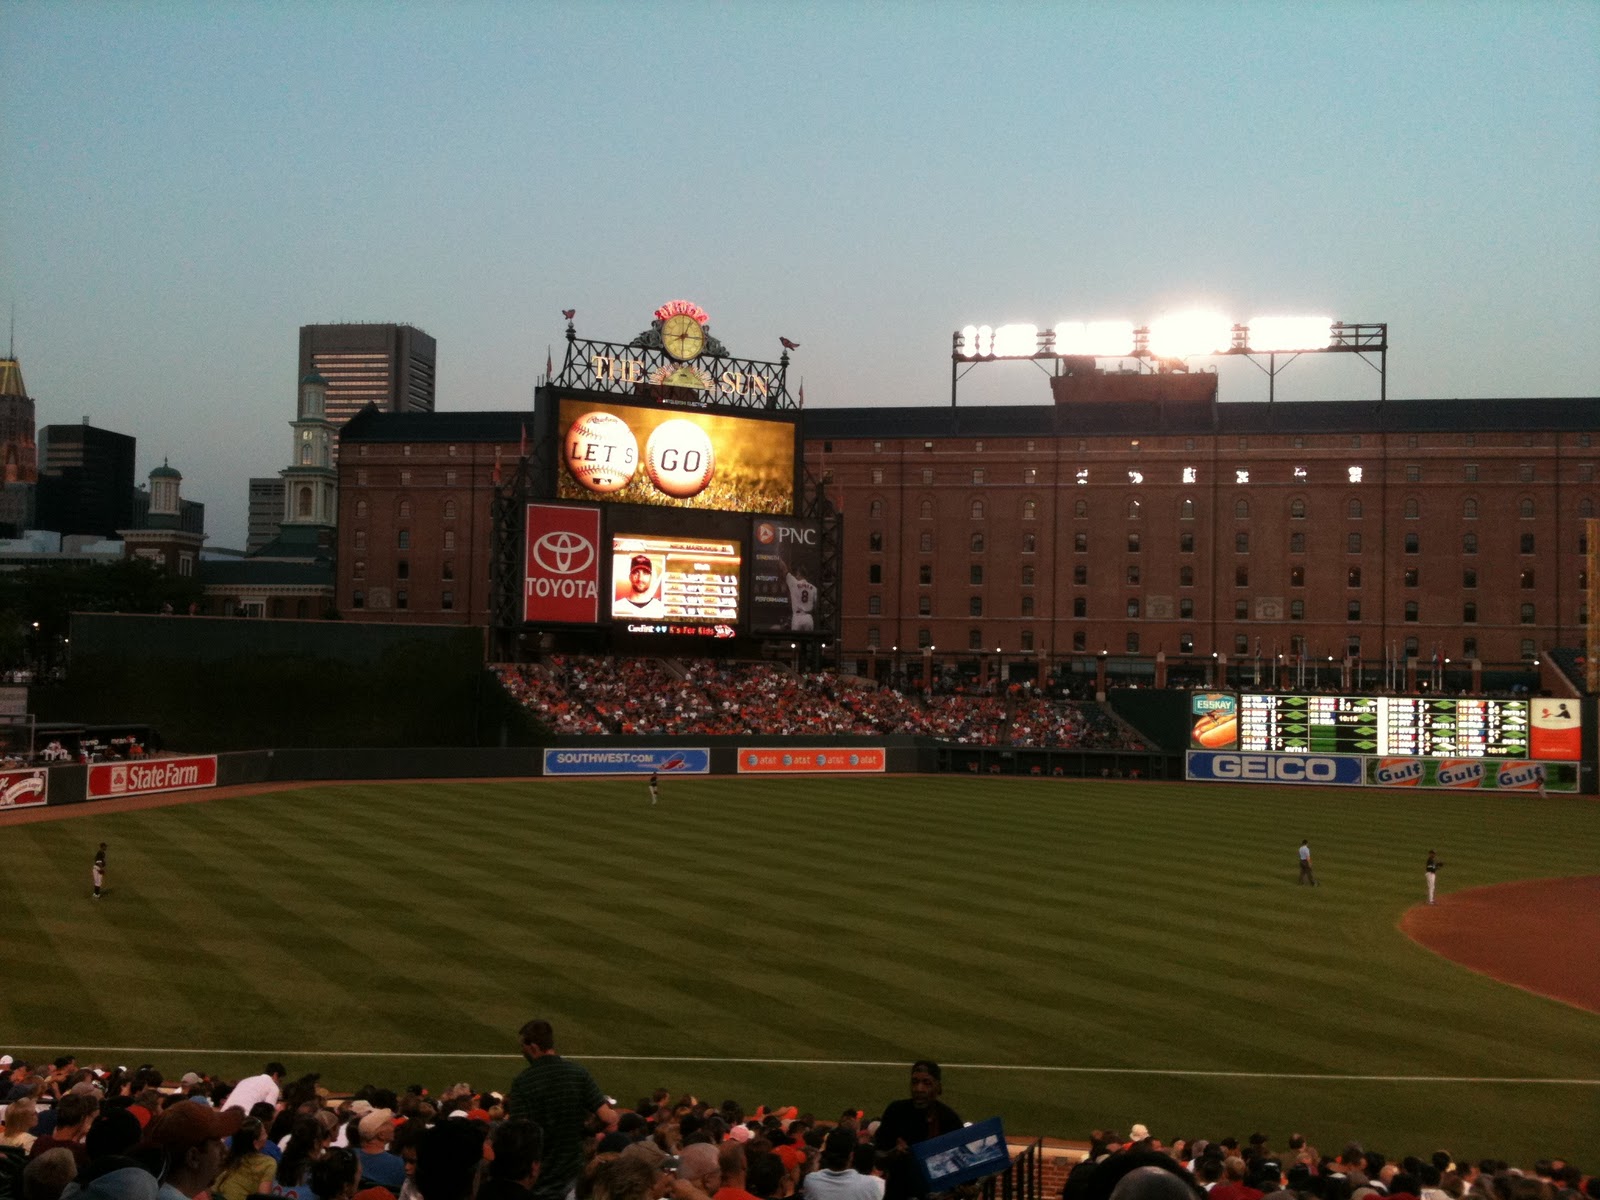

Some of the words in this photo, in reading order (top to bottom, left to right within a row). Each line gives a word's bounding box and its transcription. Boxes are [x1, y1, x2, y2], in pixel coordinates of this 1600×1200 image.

[591, 355, 645, 384] THE
[722, 371, 769, 397] SUN
[661, 448, 701, 473] GO
[778, 526, 816, 545] PNC
[525, 577, 598, 599] TOYOTA
[1197, 700, 1232, 709] ESSKAY
[556, 753, 654, 764] SOUTHWEST.COM
[1212, 754, 1337, 781] GEICO
[1378, 763, 1421, 782] Gulf
[1438, 764, 1481, 785] Gulf
[1499, 766, 1542, 786] Gulf
